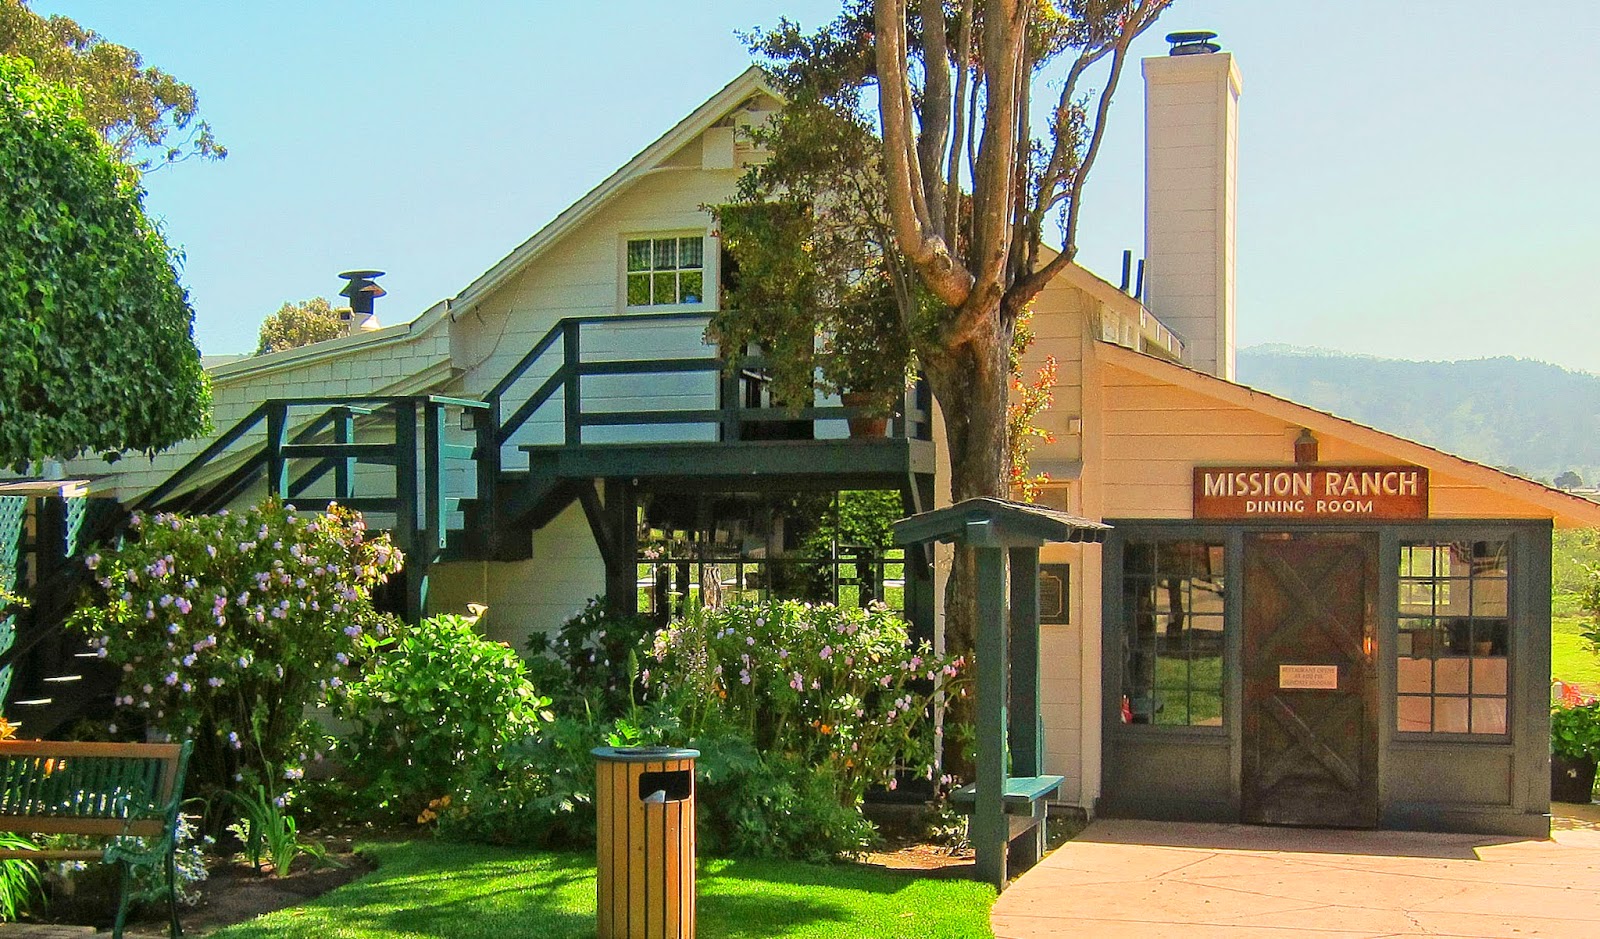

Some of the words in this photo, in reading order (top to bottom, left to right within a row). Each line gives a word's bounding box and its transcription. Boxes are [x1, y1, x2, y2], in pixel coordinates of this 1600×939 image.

[1204, 472, 1312, 497] MISSION
[1325, 472, 1418, 496] RANCH
[1246, 500, 1305, 513] DINING
[1316, 500, 1373, 513] ROOM
